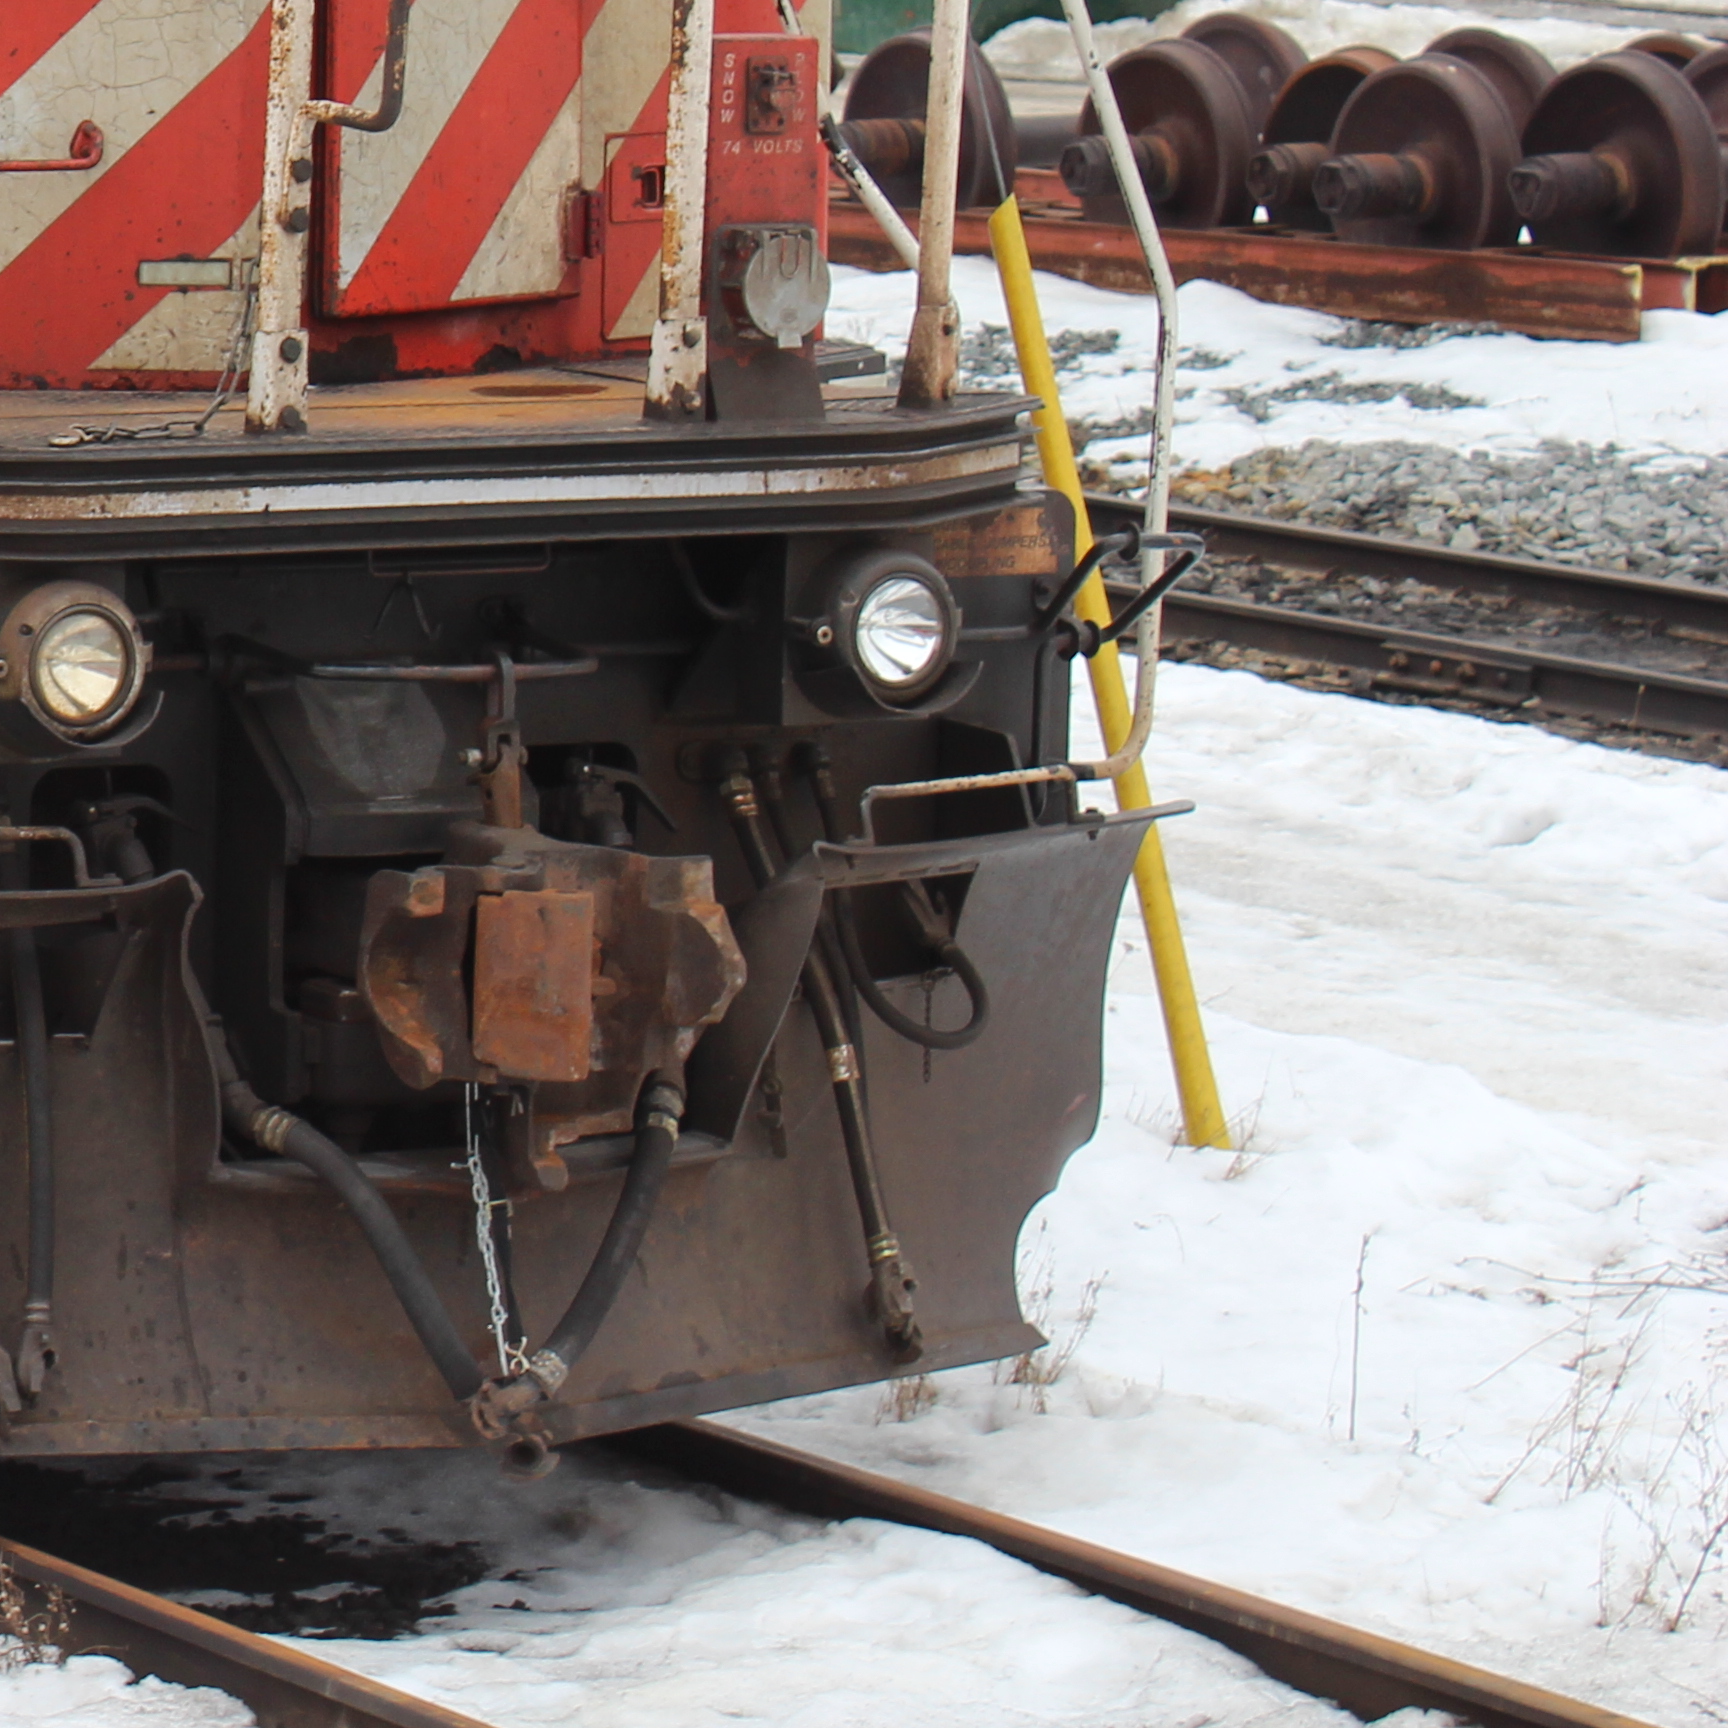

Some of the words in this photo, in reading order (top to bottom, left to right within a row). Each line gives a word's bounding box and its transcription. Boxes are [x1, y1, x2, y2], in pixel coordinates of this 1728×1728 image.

[721, 53, 735, 123] SNOW
[723, 140, 741, 154] 74
[753, 139, 803, 154] VOLTS
